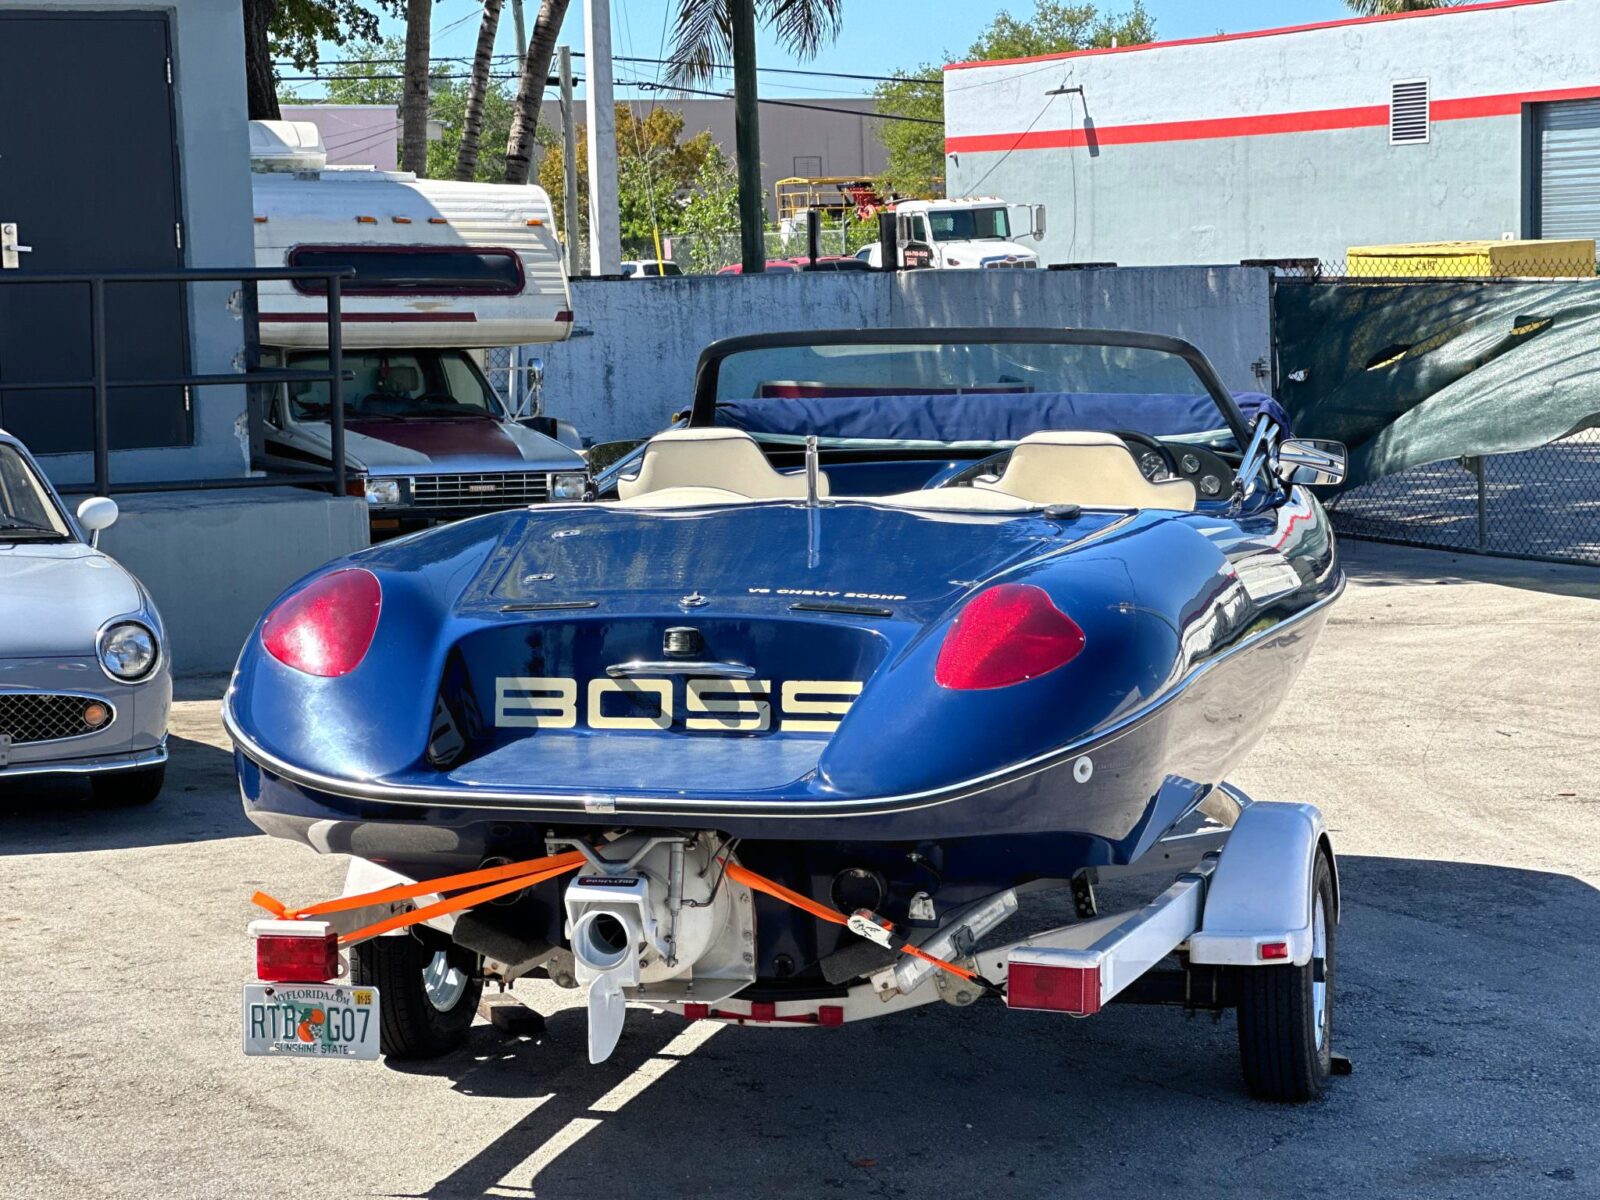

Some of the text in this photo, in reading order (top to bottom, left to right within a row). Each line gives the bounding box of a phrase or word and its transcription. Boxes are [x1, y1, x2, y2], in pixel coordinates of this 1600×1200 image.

[776, 588, 841, 597] CHEVY
[843, 592, 908, 600] 200HP
[495, 677, 863, 732] BOSS
[273, 989, 350, 1005] MYFLORIDA.COM
[251, 1004, 296, 1040] RTB
[274, 1043, 349, 1055] SUNSHINE STATE
